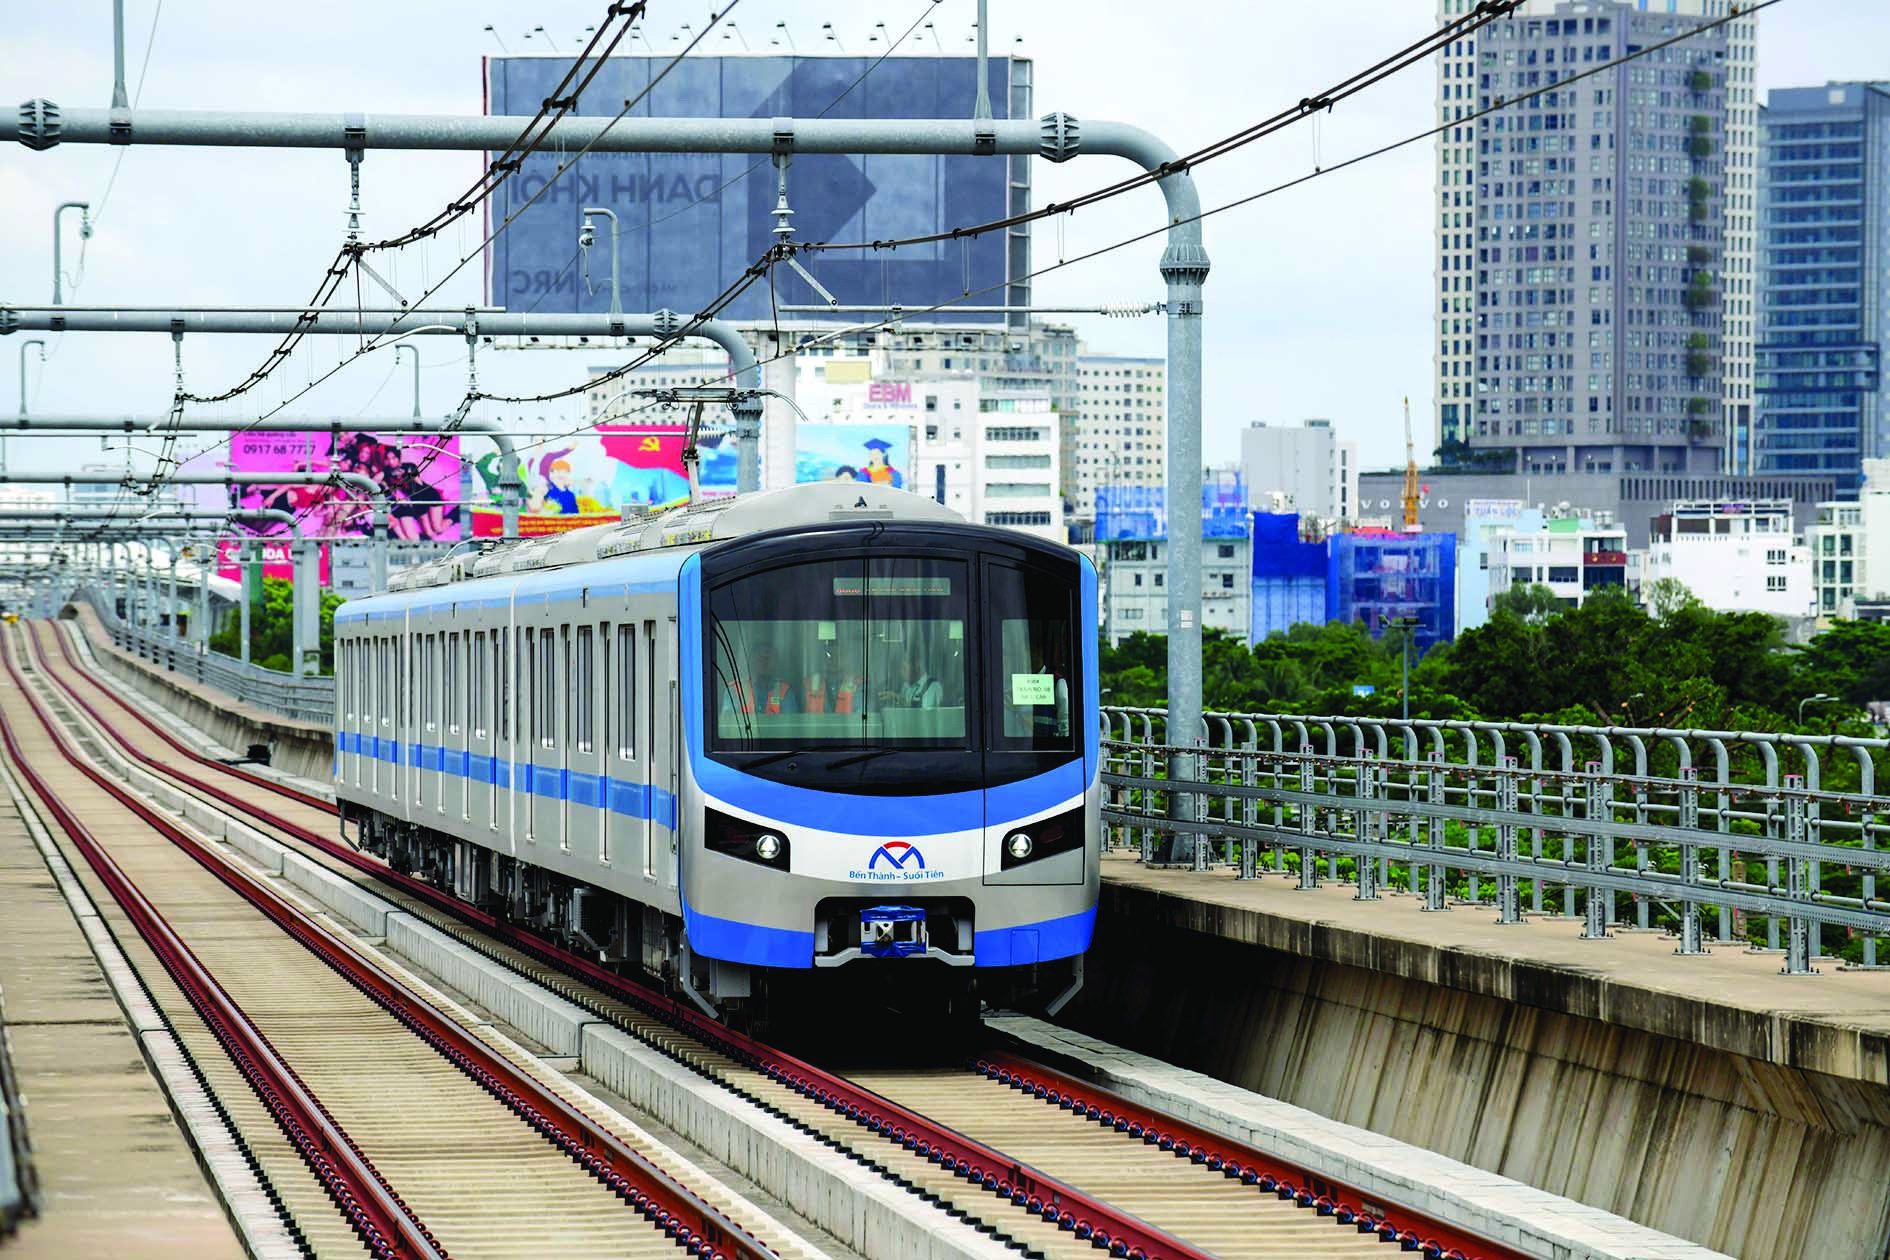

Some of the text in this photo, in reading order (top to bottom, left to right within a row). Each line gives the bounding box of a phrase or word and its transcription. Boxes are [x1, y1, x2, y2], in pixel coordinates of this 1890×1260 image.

[869, 384, 912, 402] EBM
[243, 444, 272, 455] 0917
[273, 444, 288, 455] 68
[868, 872, 895, 880] Thành
